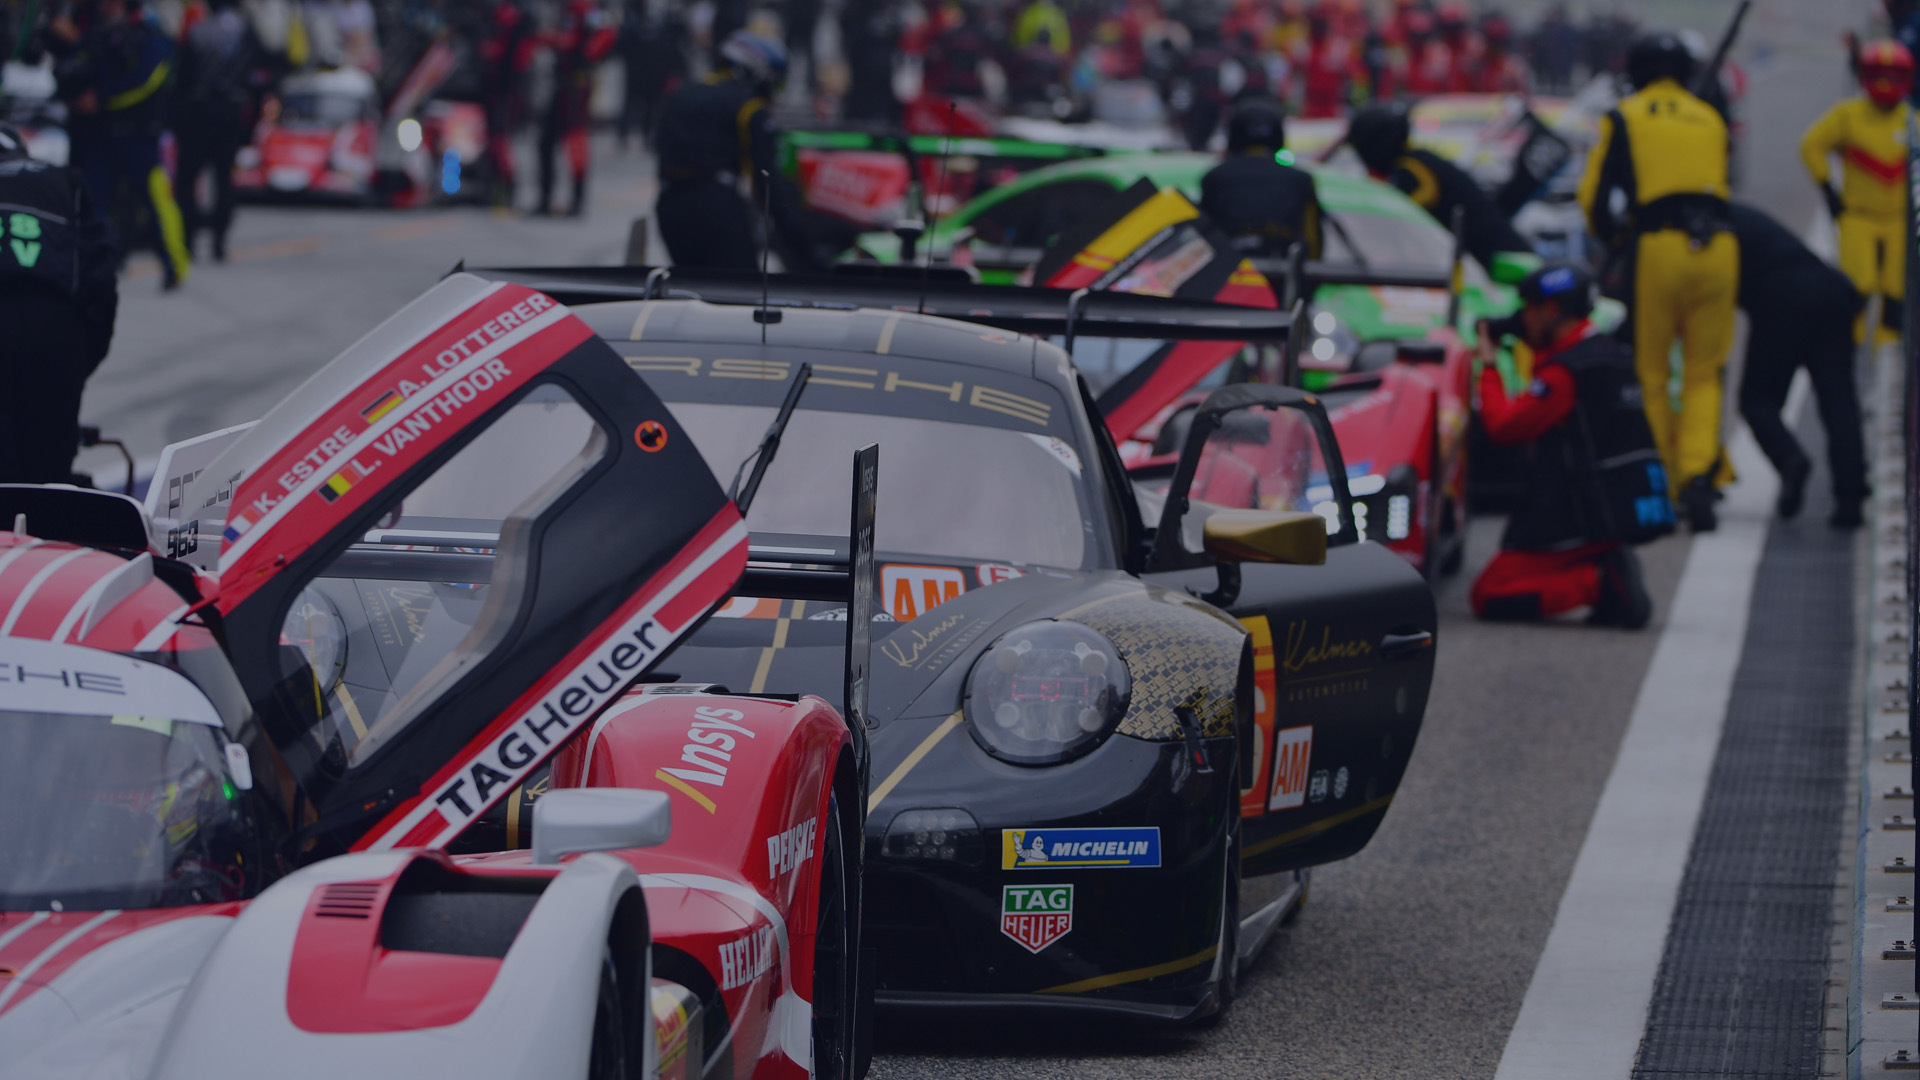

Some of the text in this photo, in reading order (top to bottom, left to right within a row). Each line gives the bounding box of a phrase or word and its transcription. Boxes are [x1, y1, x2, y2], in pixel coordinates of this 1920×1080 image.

[0, 237, 42, 268] V
[397, 292, 552, 400] A. LOTTERER
[351, 357, 512, 479] L. VANTHOOR
[252, 491, 285, 515] K.
[278, 424, 357, 492] ESTRE
[167, 519, 199, 559] 963
[894, 578, 960, 621] AM
[881, 614, 965, 668] Kalmar
[1282, 619, 1373, 675] Kalmar
[655, 705, 756, 816] Ansys
[1273, 741, 1310, 796] AM
[767, 816, 817, 880] PENSKE
[1051, 841, 1150, 857] MICHELIN
[1009, 888, 1068, 911] TAG
[1005, 914, 1068, 949] HEUER
